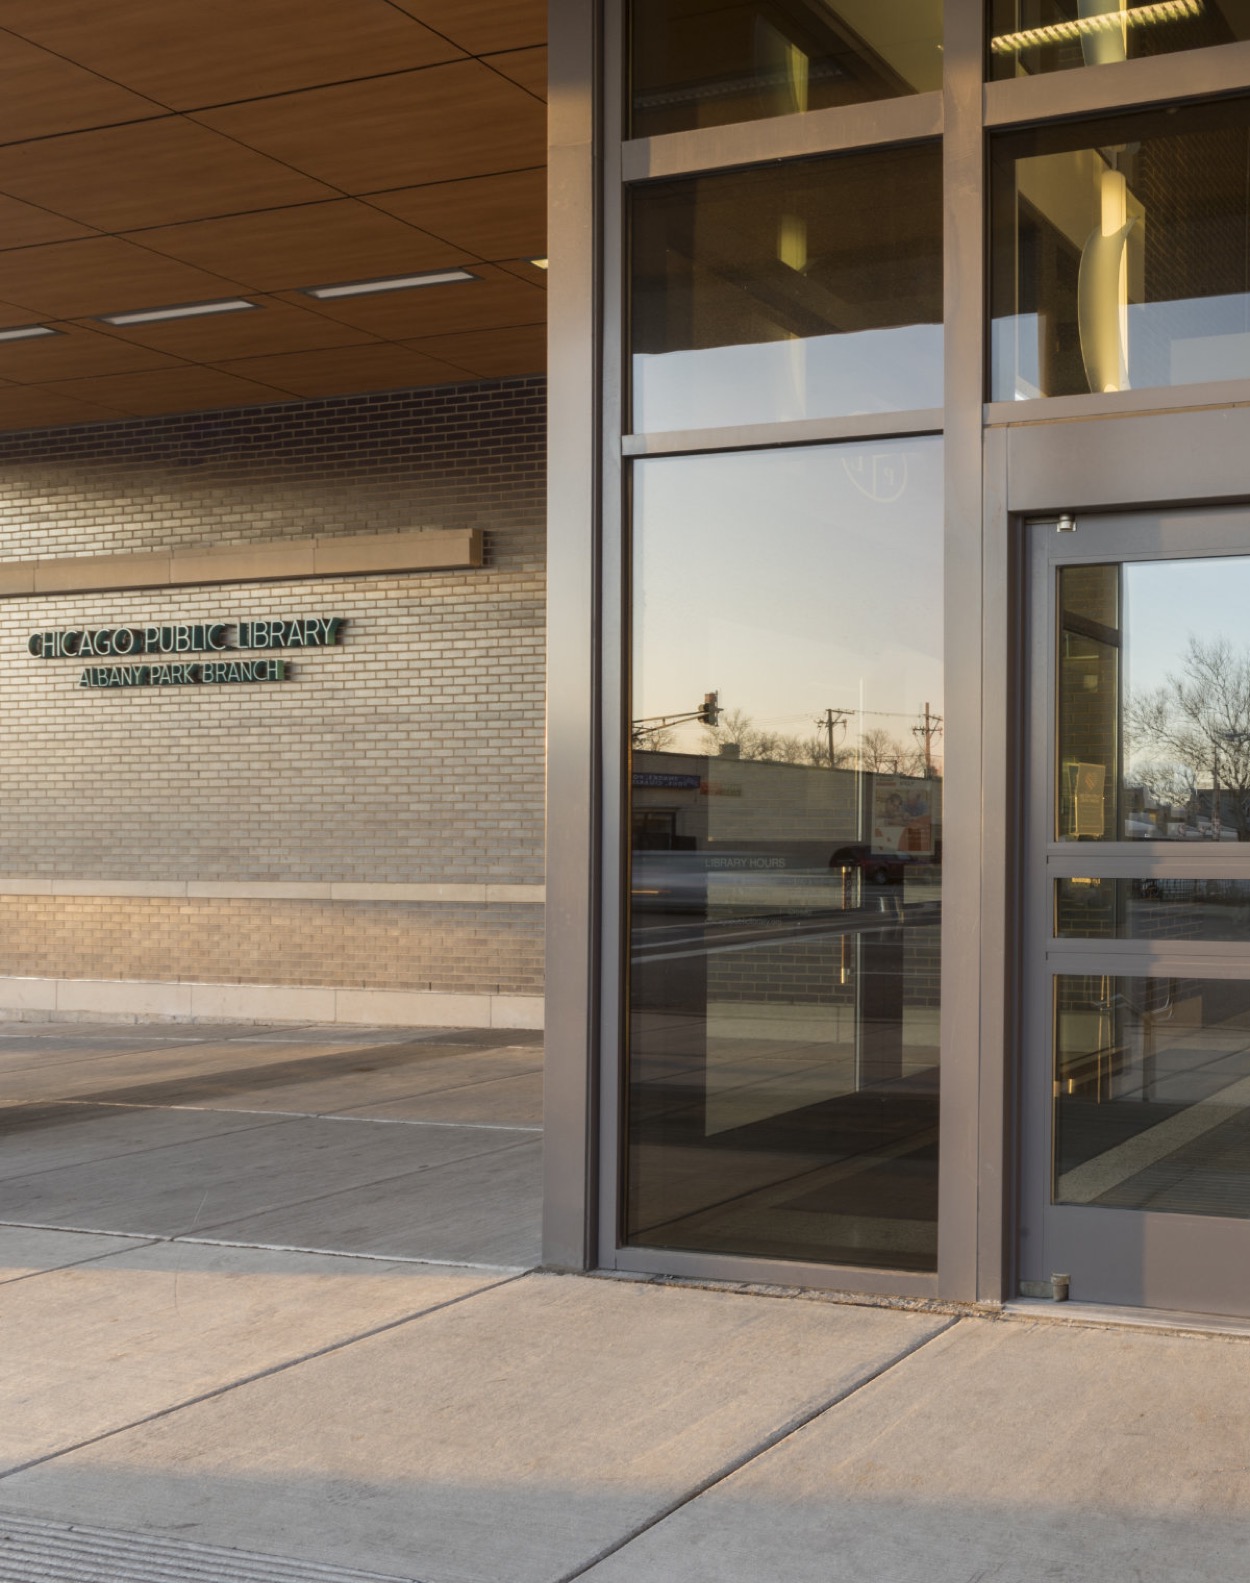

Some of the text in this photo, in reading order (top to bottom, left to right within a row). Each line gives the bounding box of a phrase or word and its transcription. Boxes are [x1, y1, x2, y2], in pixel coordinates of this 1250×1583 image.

[27, 616, 344, 659] CHICAGO PUBLIC LIBRARY
[79, 659, 281, 688] ALBANY PARK BRANCH
[705, 857, 786, 868] LIBRARY HOURS
